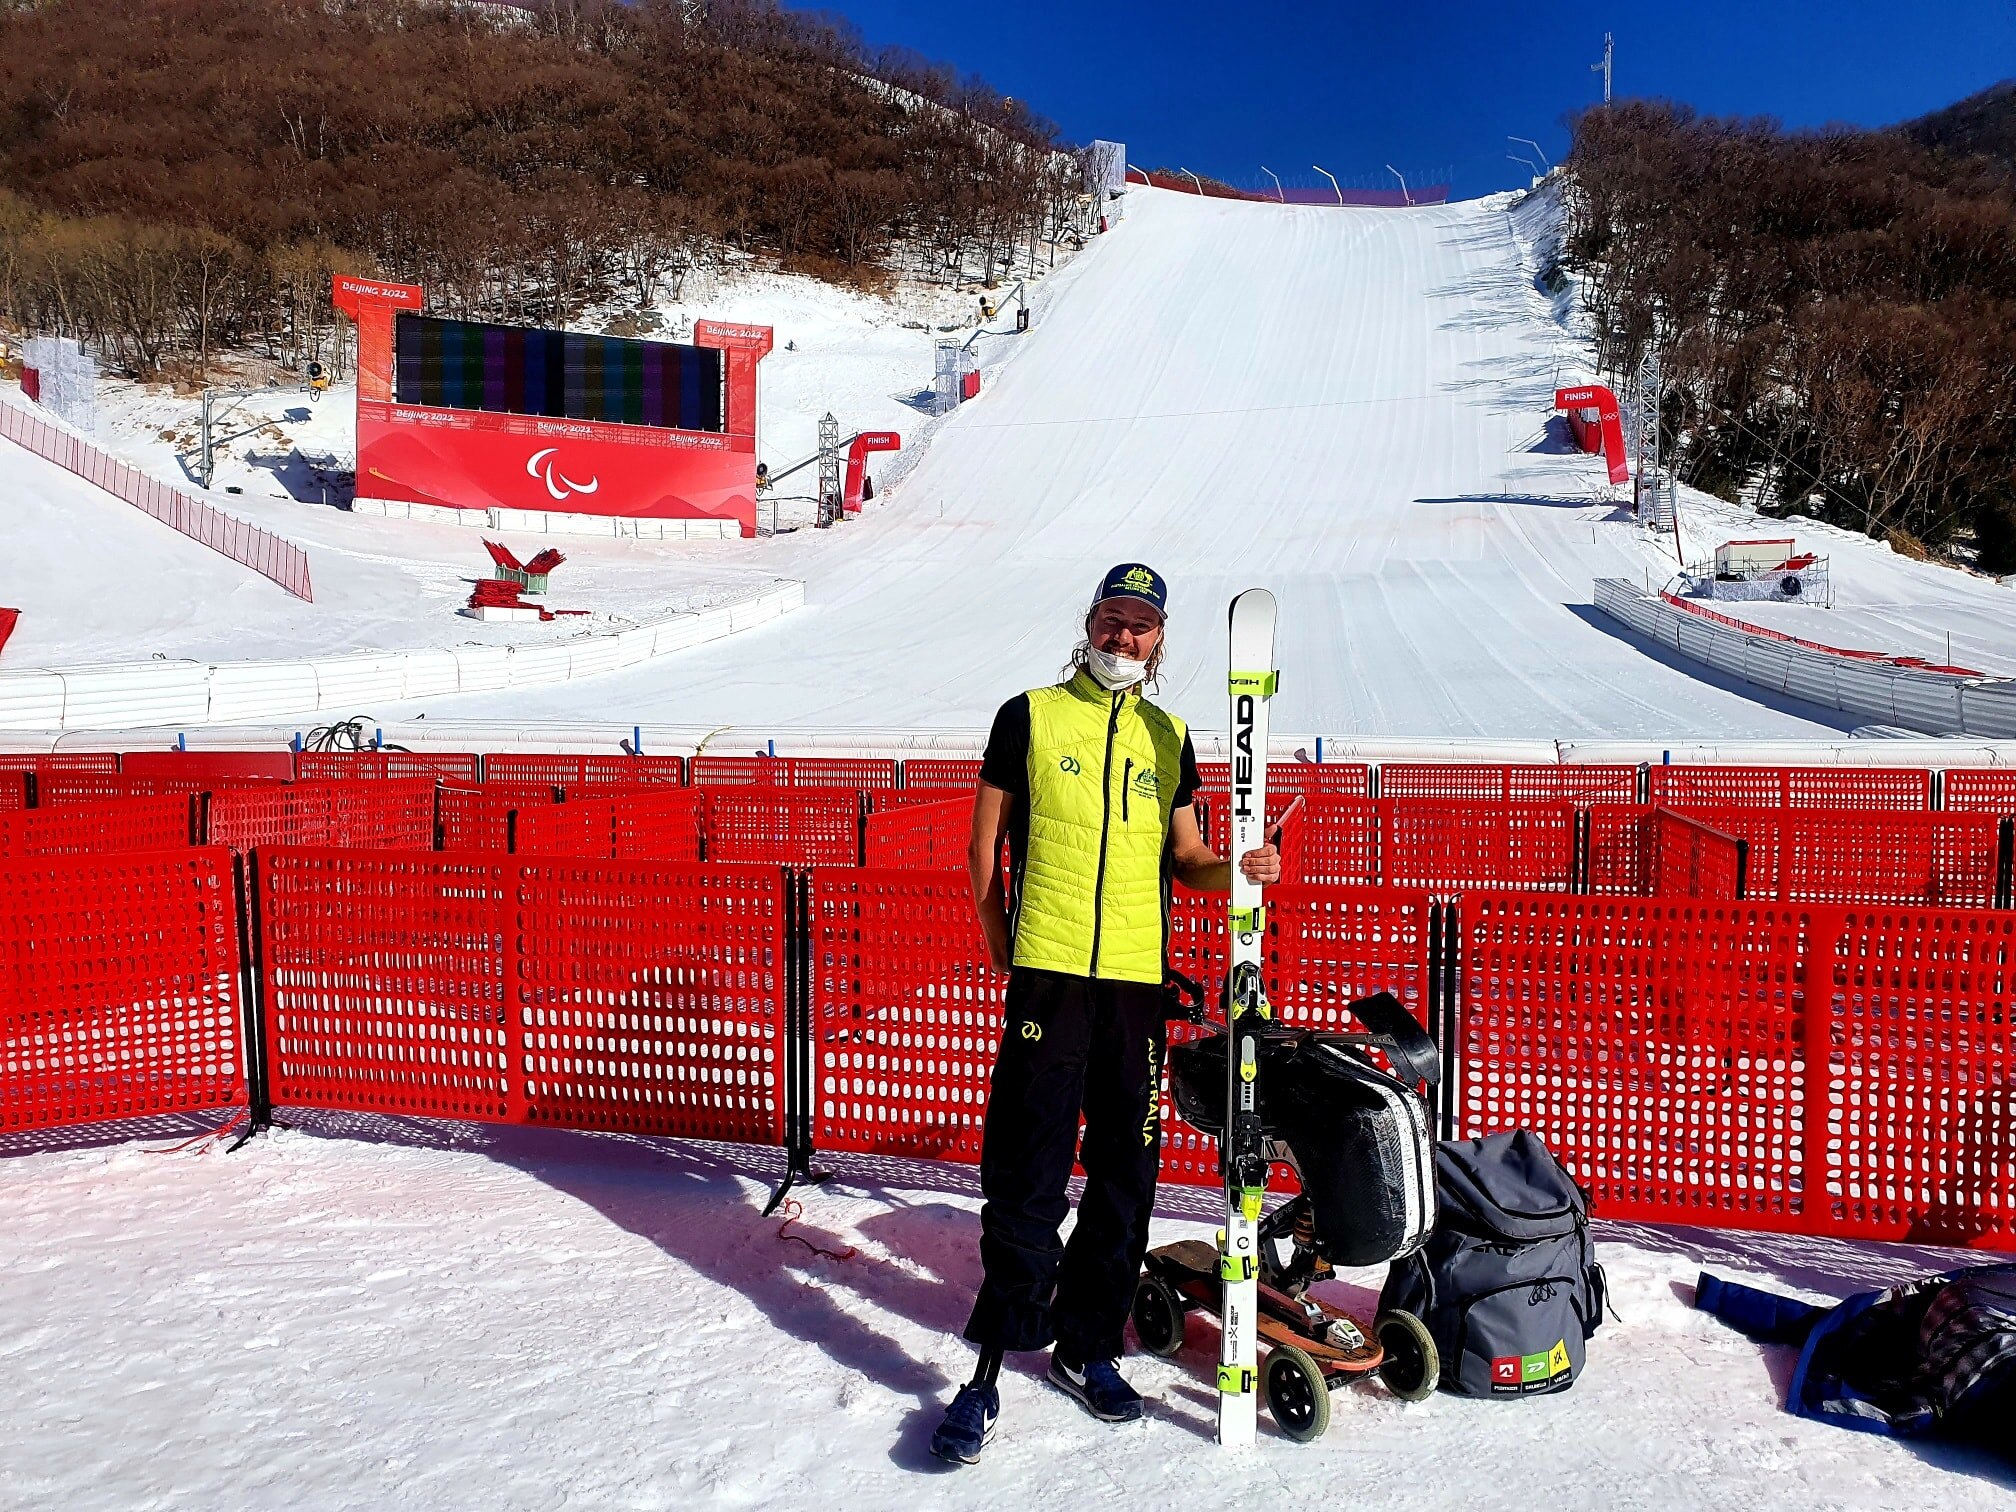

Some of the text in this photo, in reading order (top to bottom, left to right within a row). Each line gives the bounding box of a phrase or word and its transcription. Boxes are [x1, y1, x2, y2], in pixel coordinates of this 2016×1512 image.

[342, 281, 409, 299] BEIJING 2022
[706, 325, 763, 338] BEIJING 2022
[1564, 391, 1593, 401] FINISH
[396, 409, 455, 422] BEIJING 2022
[537, 422, 593, 434] BEIJING 2022
[669, 434, 722, 446] BEIJING 2022
[1229, 678, 1259, 686] HEA
[1235, 694, 1254, 816] HEAD
[1142, 1037, 1159, 1147] AUSTRALIA
